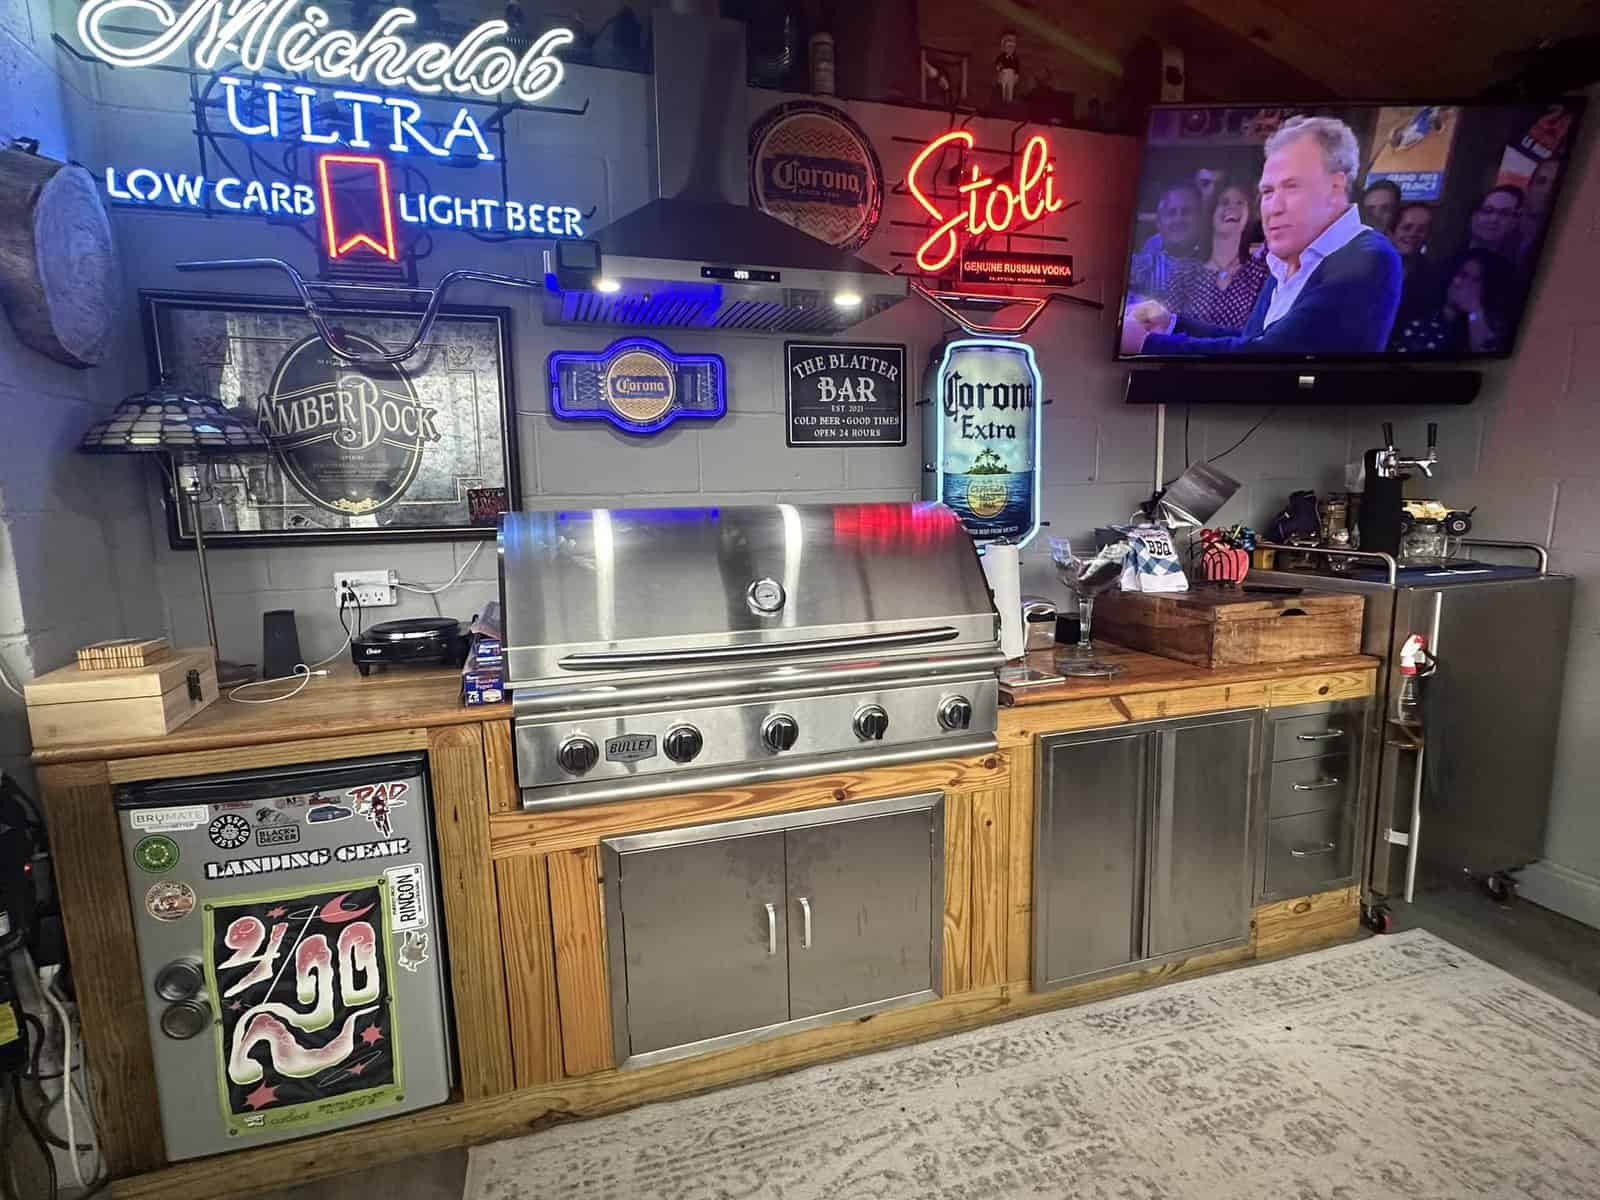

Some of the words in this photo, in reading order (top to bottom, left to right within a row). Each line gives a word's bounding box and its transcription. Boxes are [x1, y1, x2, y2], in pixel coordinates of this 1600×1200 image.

[77, 0, 574, 101] Michelob
[219, 76, 496, 161] ULTRA
[105, 167, 203, 204] LOW
[216, 177, 315, 216] CARB
[772, 160, 860, 193] Corona
[399, 193, 500, 232] LIGHT
[505, 201, 584, 238] BEER
[910, 130, 1062, 271] Stoli
[964, 261, 1003, 274] GENUINE
[1003, 263, 1041, 275] RUSSIAN
[1041, 264, 1072, 276] VODKA
[793, 356, 827, 379] THE
[828, 353, 899, 382] BLATTER
[616, 377, 665, 394] Corona
[817, 376, 878, 402] BAR
[256, 389, 359, 437] AMBER
[333, 375, 441, 450] BOCK
[794, 416, 817, 425] COLD
[819, 416, 841, 425] BEER
[846, 416, 871, 425] GOOD
[871, 416, 900, 425] TIMES
[961, 414, 1016, 440] Extra
[813, 428, 836, 437] OPEN
[839, 428, 849, 437] 24
[851, 428, 881, 437] HOURS
[1146, 540, 1172, 556] BBQ
[610, 740, 652, 754] BULLET
[205, 848, 331, 880] LANDING
[335, 838, 411, 862] GEAR
[396, 874, 417, 922] RINCON
